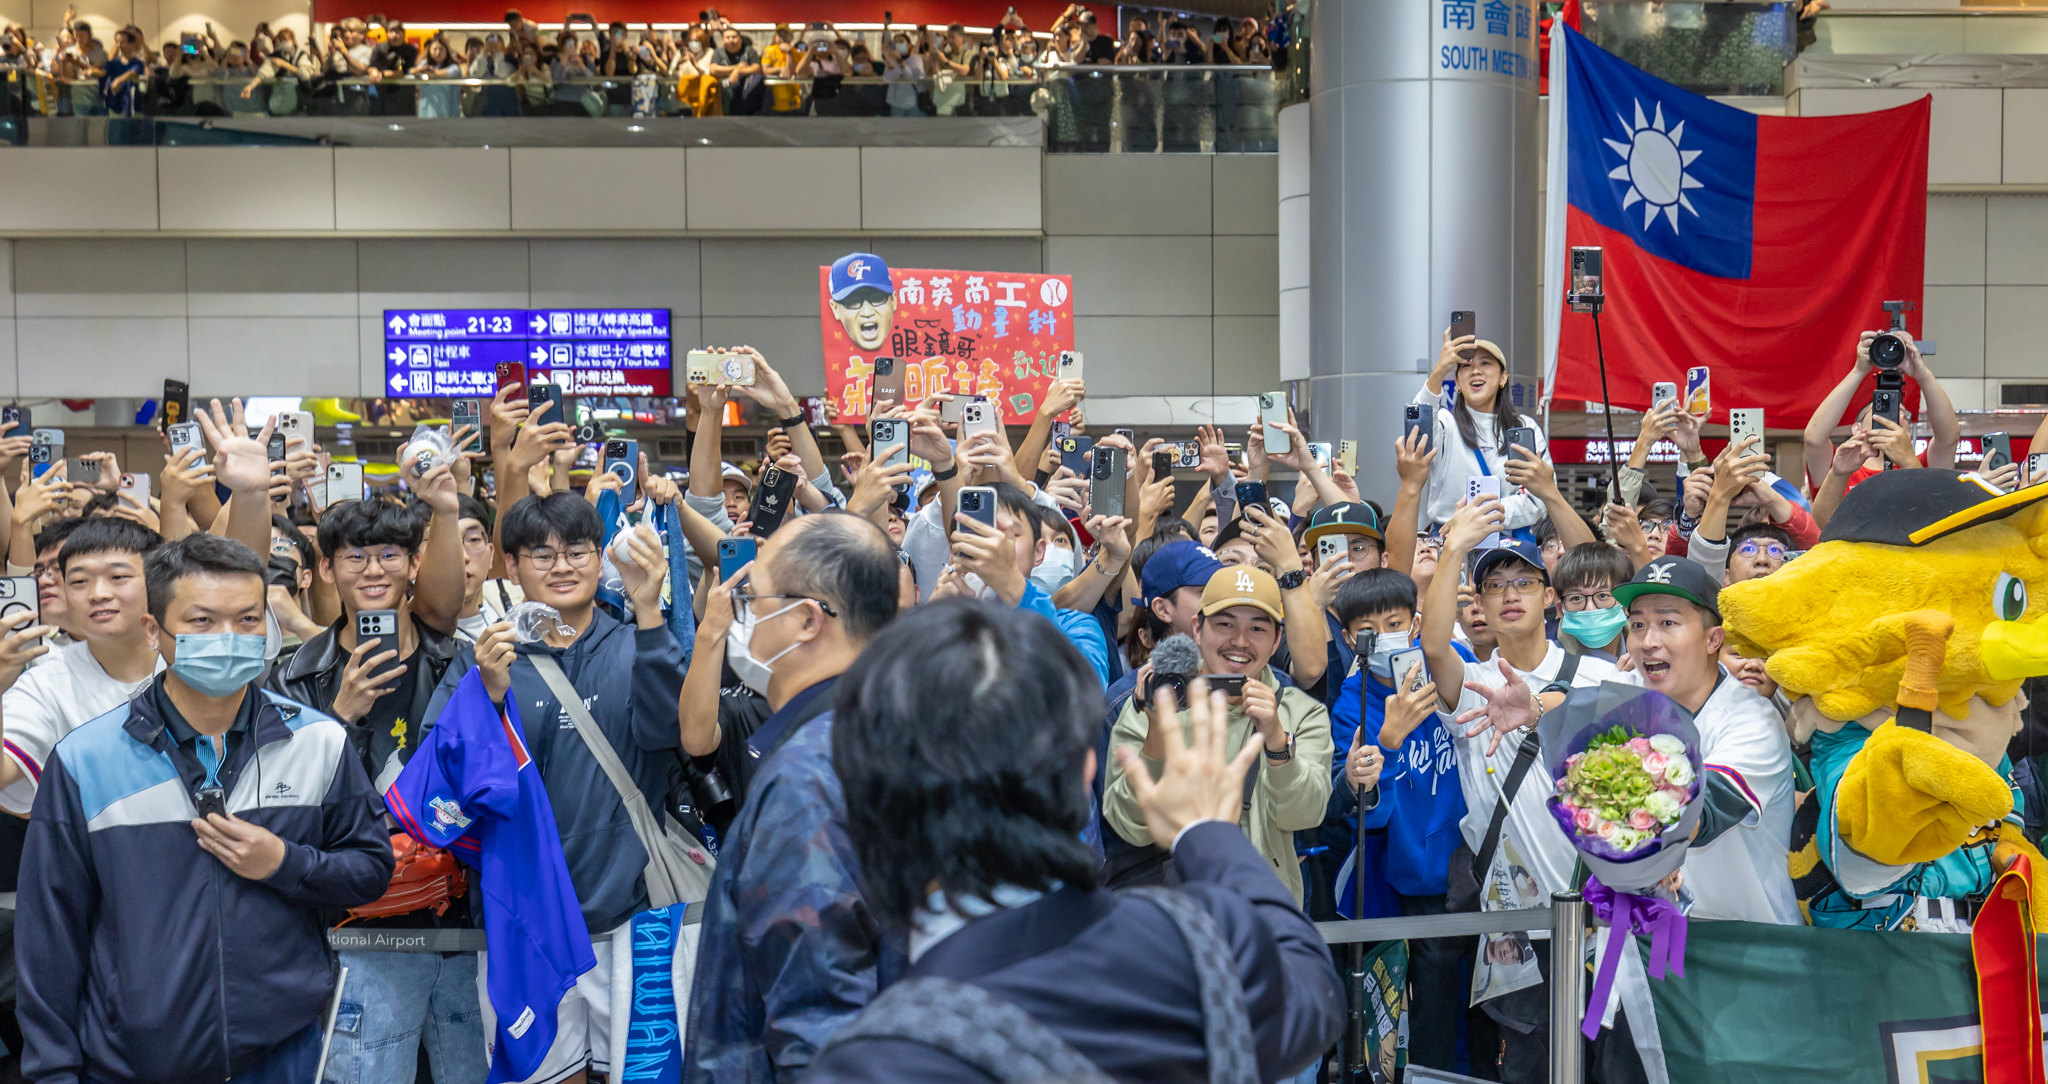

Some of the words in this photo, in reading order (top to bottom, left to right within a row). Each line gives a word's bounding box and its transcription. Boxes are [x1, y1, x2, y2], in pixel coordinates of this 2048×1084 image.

[1441, 45, 1488, 71] SOUTH
[408, 312, 446, 327] 會面點
[467, 316, 512, 333] 21-23
[408, 327, 443, 340] Meeting
[444, 327, 467, 339] point
[574, 326, 593, 335] MRT
[598, 326, 608, 335] To
[609, 326, 627, 338] High
[628, 326, 652, 338] Speed
[653, 326, 667, 335] Rail
[433, 344, 470, 359] 計程車
[434, 358, 450, 368] Taxi
[575, 358, 590, 367] Bus
[592, 358, 601, 367] to
[602, 358, 617, 370] city
[624, 358, 643, 367] Tour
[644, 358, 660, 367] bus
[435, 370, 497, 385] 報到大廳(3
[575, 369, 626, 385] 外幣兌換
[434, 385, 477, 397] Departure
[477, 384, 493, 394] hall
[575, 384, 612, 397] Currency
[613, 383, 654, 397] exchange
[1586, 453, 1603, 464] Duty
[1331, 504, 1351, 523] T
[1235, 570, 1254, 592] LA
[375, 933, 426, 949] Airport
